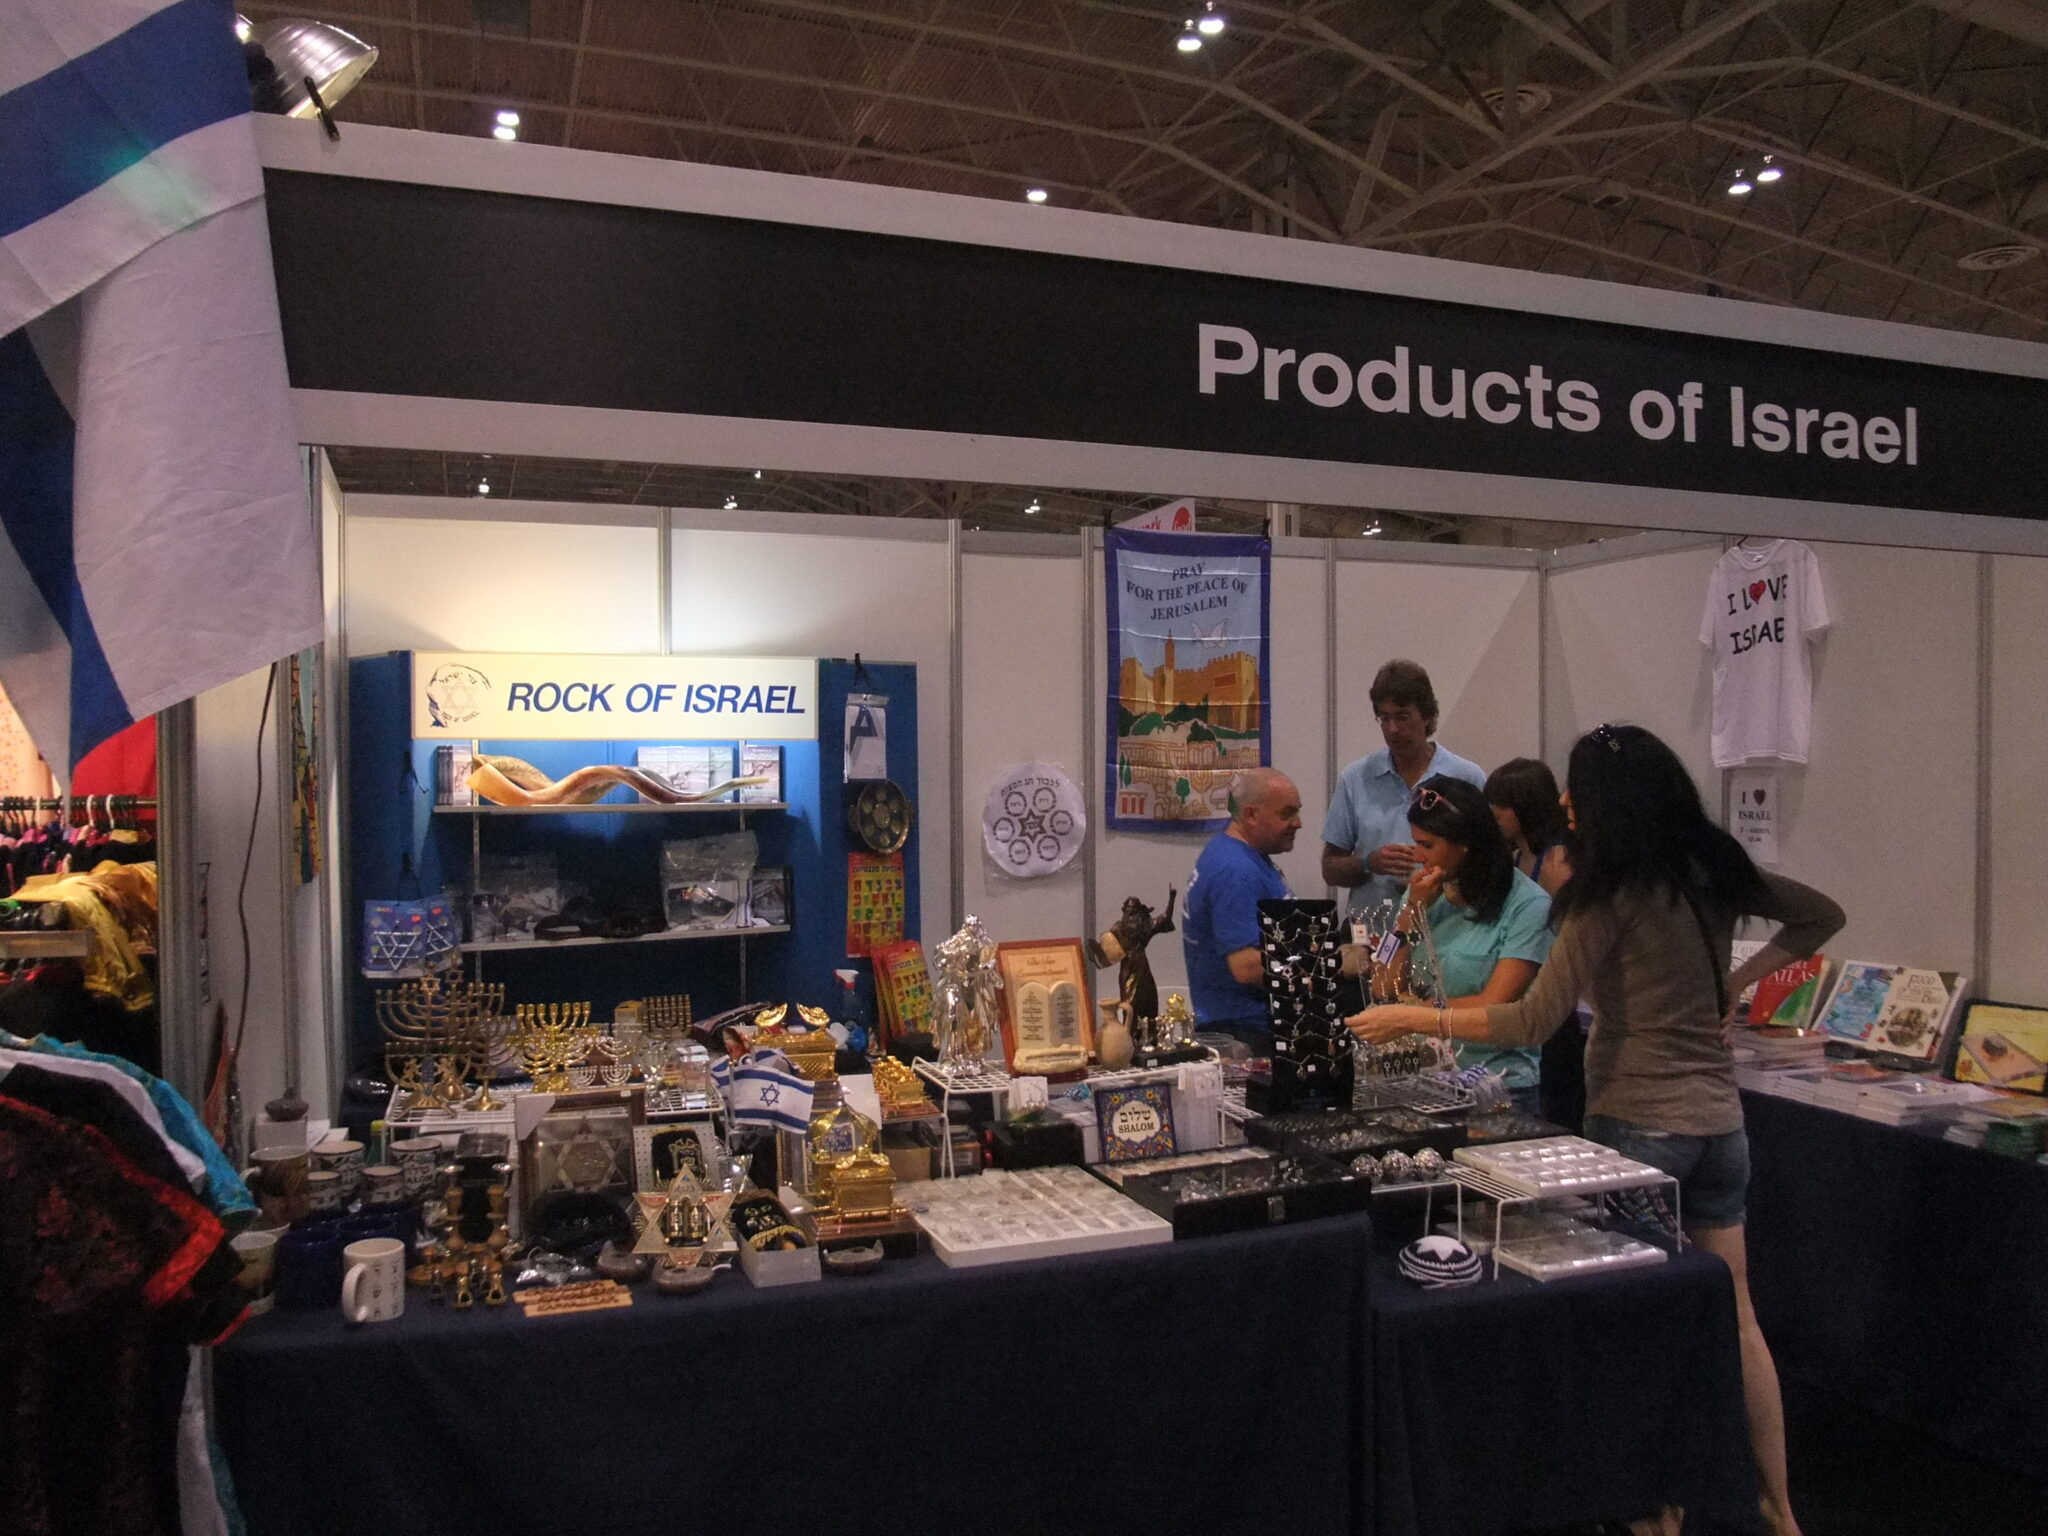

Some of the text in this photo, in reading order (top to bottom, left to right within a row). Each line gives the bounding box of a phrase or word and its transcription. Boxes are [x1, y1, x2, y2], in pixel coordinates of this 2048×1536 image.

[1198, 323, 1918, 466] Products of Israel
[1172, 562, 1206, 581] PRAY
[1127, 577, 1249, 601] FOR THE PEACE OF
[1150, 596, 1229, 620] JERUSALEM
[1727, 593, 1737, 616] I
[507, 682, 806, 714] ROCK OF ISRAEL
[1738, 810, 1771, 821] ISRAEL
[1120, 1107, 1151, 1123] שלום
[1118, 1122, 1154, 1134] SHALOM
